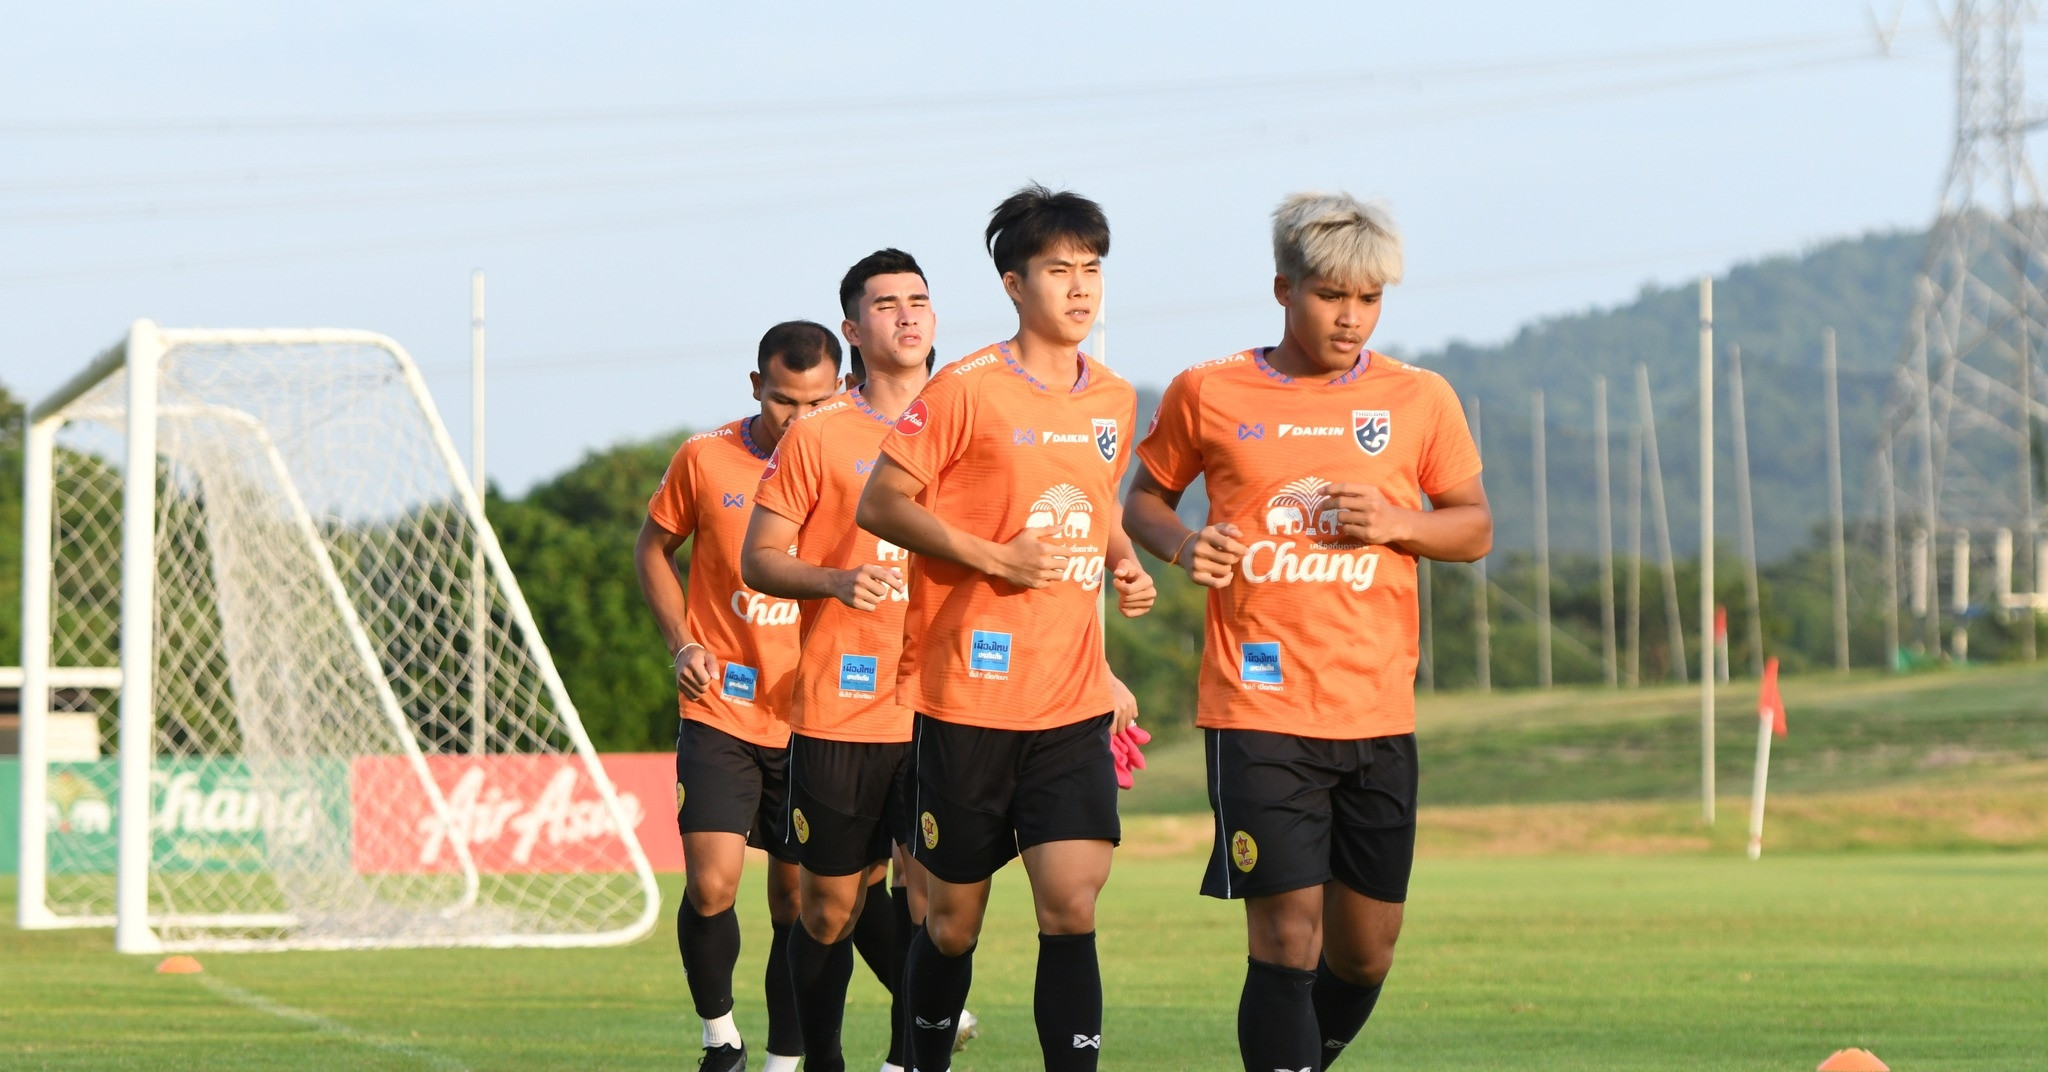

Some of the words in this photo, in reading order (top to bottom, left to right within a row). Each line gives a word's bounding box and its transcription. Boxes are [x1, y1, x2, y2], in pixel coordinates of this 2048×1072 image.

[952, 353, 999, 376] TOYOTA
[801, 400, 848, 420] TOYOTA
[687, 428, 733, 444] TOYOTA
[1052, 434, 1089, 443] DAIKIN
[1291, 427, 1345, 436] DAIKIN
[1242, 540, 1380, 592] Chang
[973, 640, 1009, 652] เมืองไทย
[843, 663, 875, 674] เมืองไทย
[150, 770, 322, 845] hang
